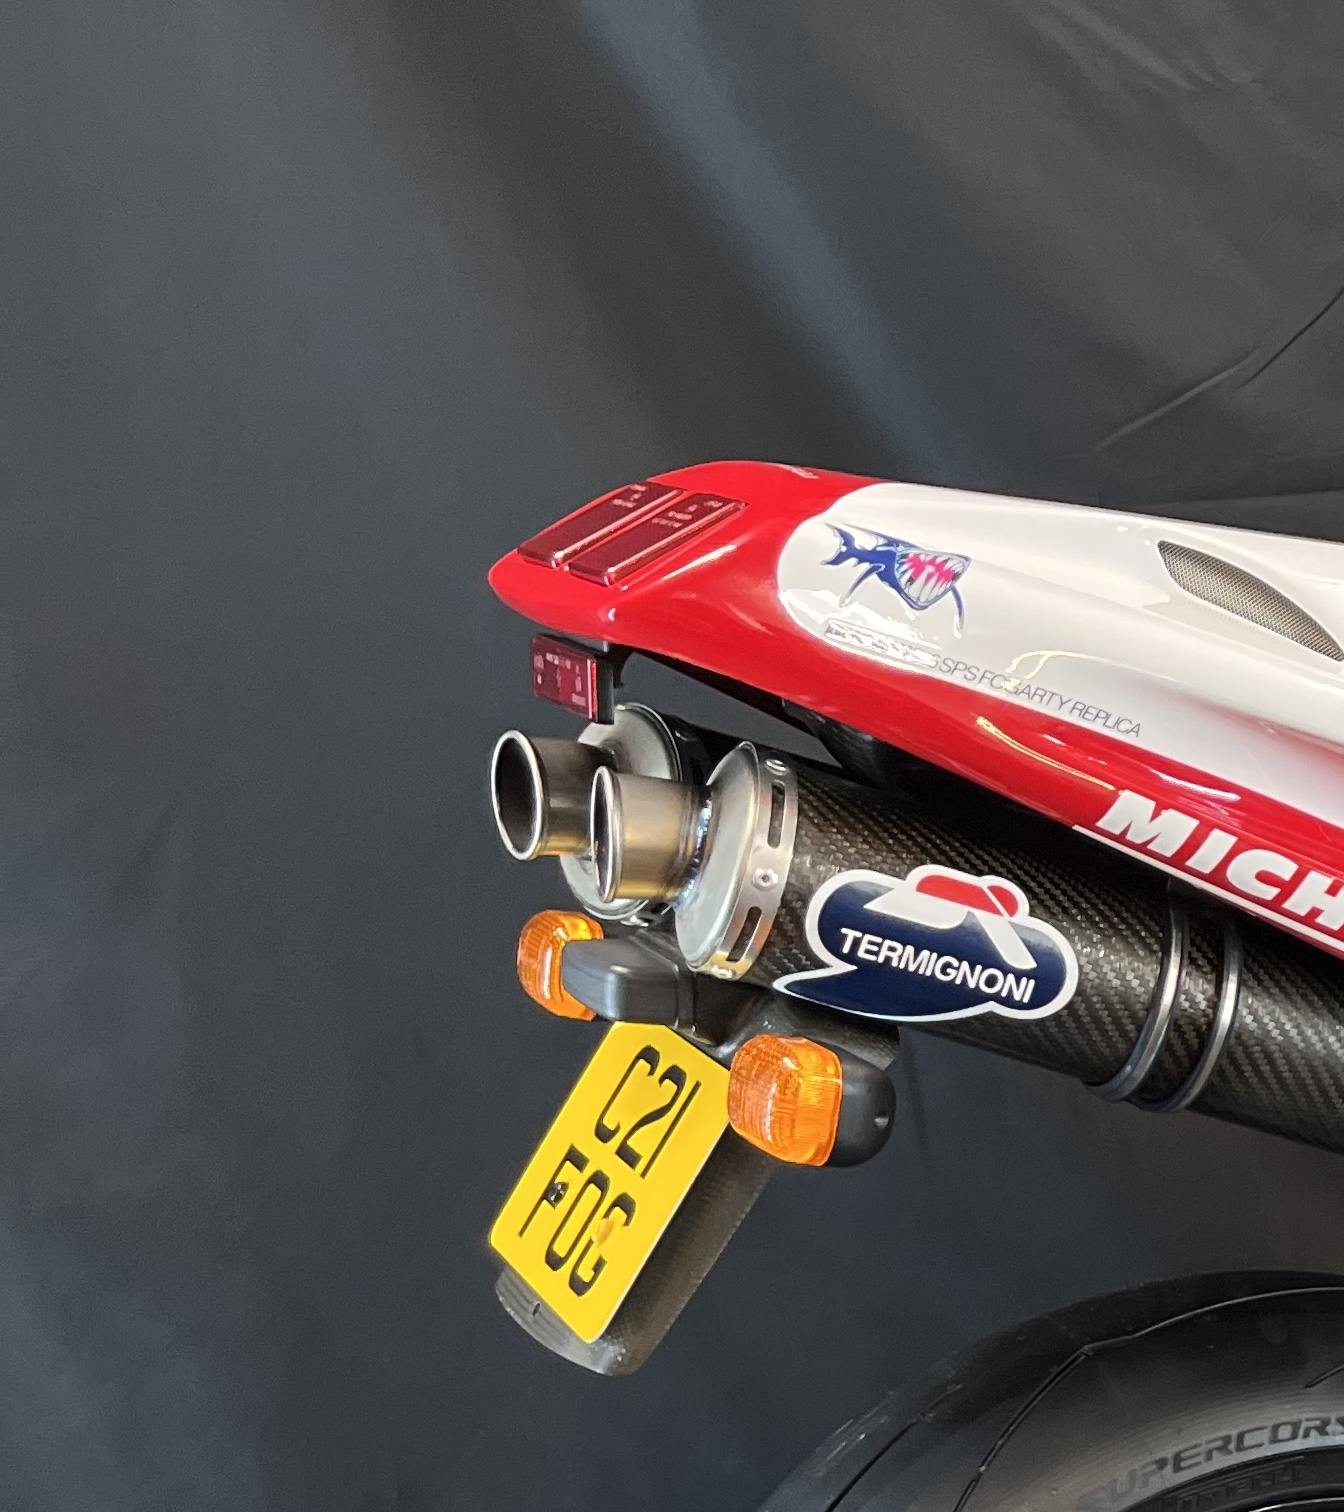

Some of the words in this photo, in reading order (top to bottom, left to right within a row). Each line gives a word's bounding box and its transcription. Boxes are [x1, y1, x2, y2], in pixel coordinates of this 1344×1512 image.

[939, 656, 981, 682] SPS
[1069, 702, 1142, 738] REPLICA
[840, 927, 1037, 1003] TERMIGNONI
[594, 1044, 702, 1179] C21
[518, 1144, 636, 1297] FOG
